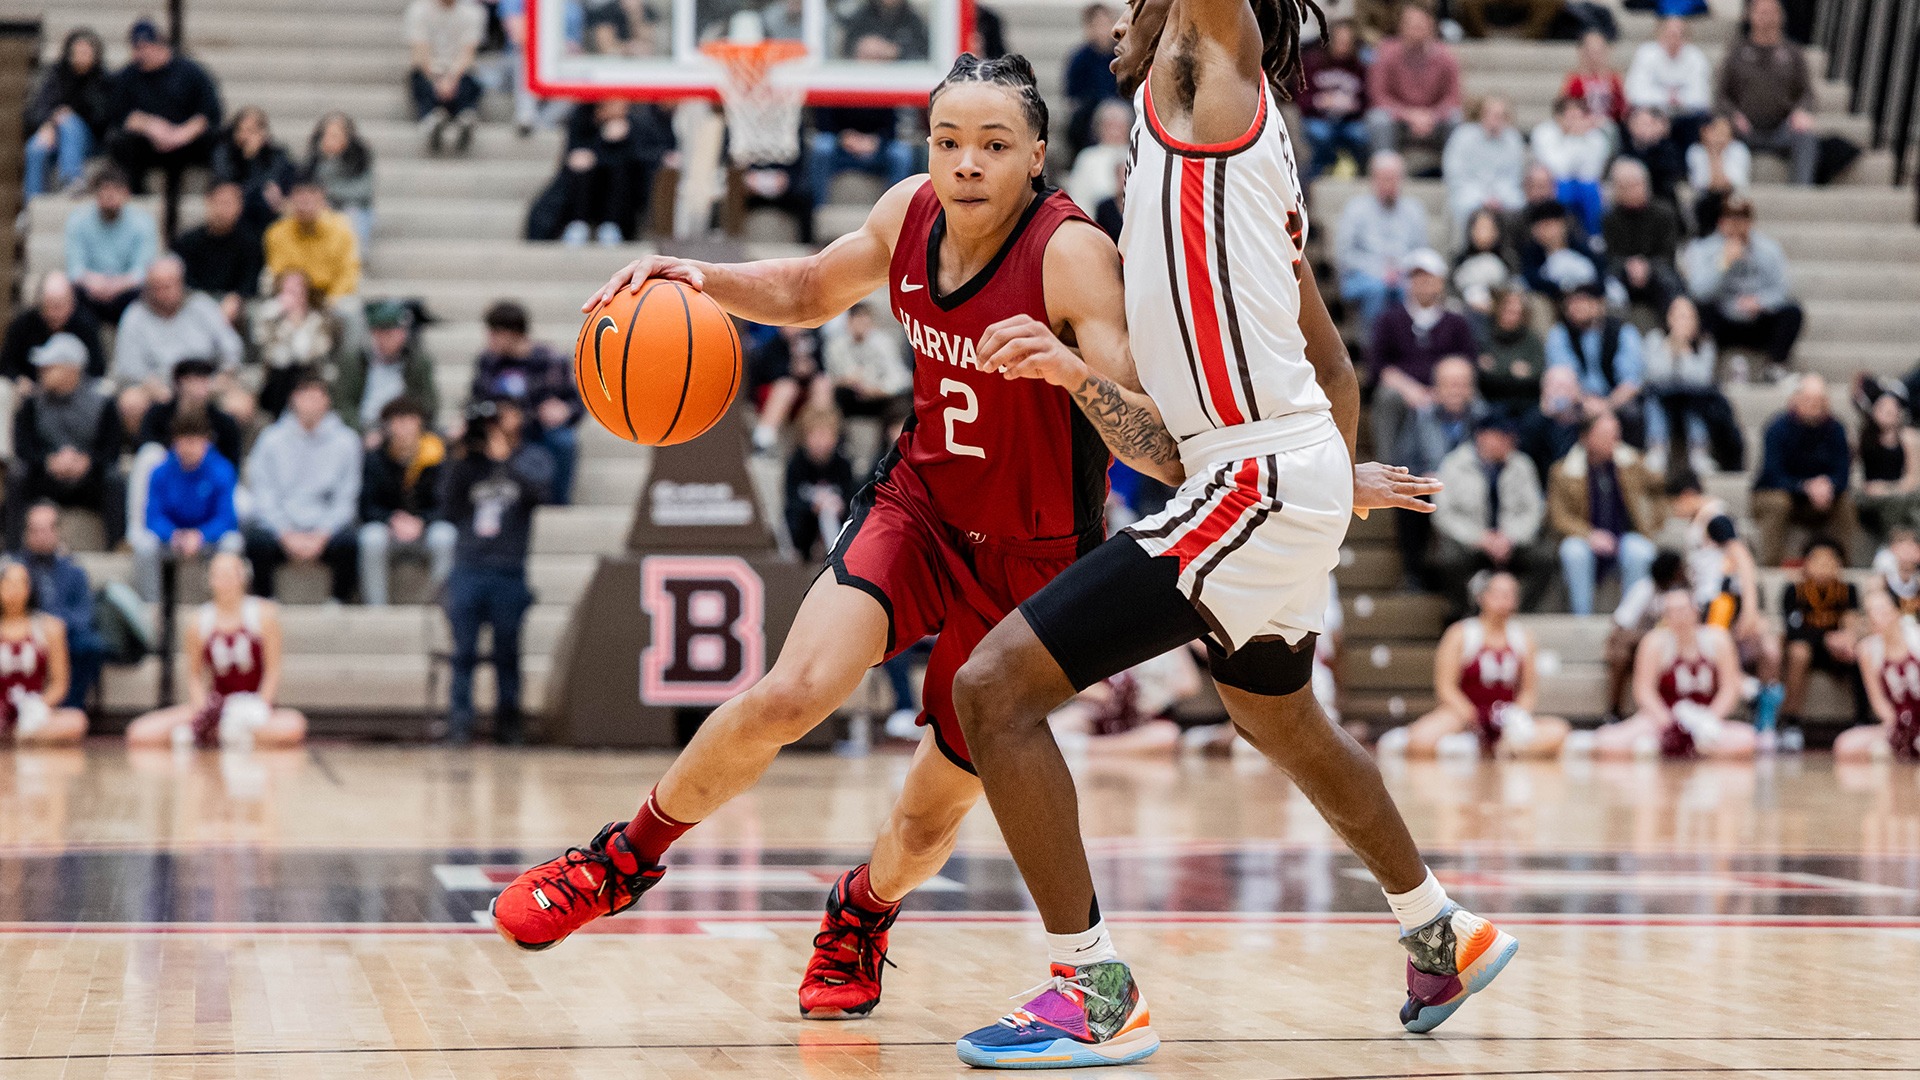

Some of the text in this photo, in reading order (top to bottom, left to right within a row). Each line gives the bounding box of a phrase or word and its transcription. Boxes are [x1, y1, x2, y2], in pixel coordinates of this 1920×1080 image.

[899, 307, 1008, 374] HARVA
[940, 378, 986, 459] 2
[640, 555, 767, 706] B
